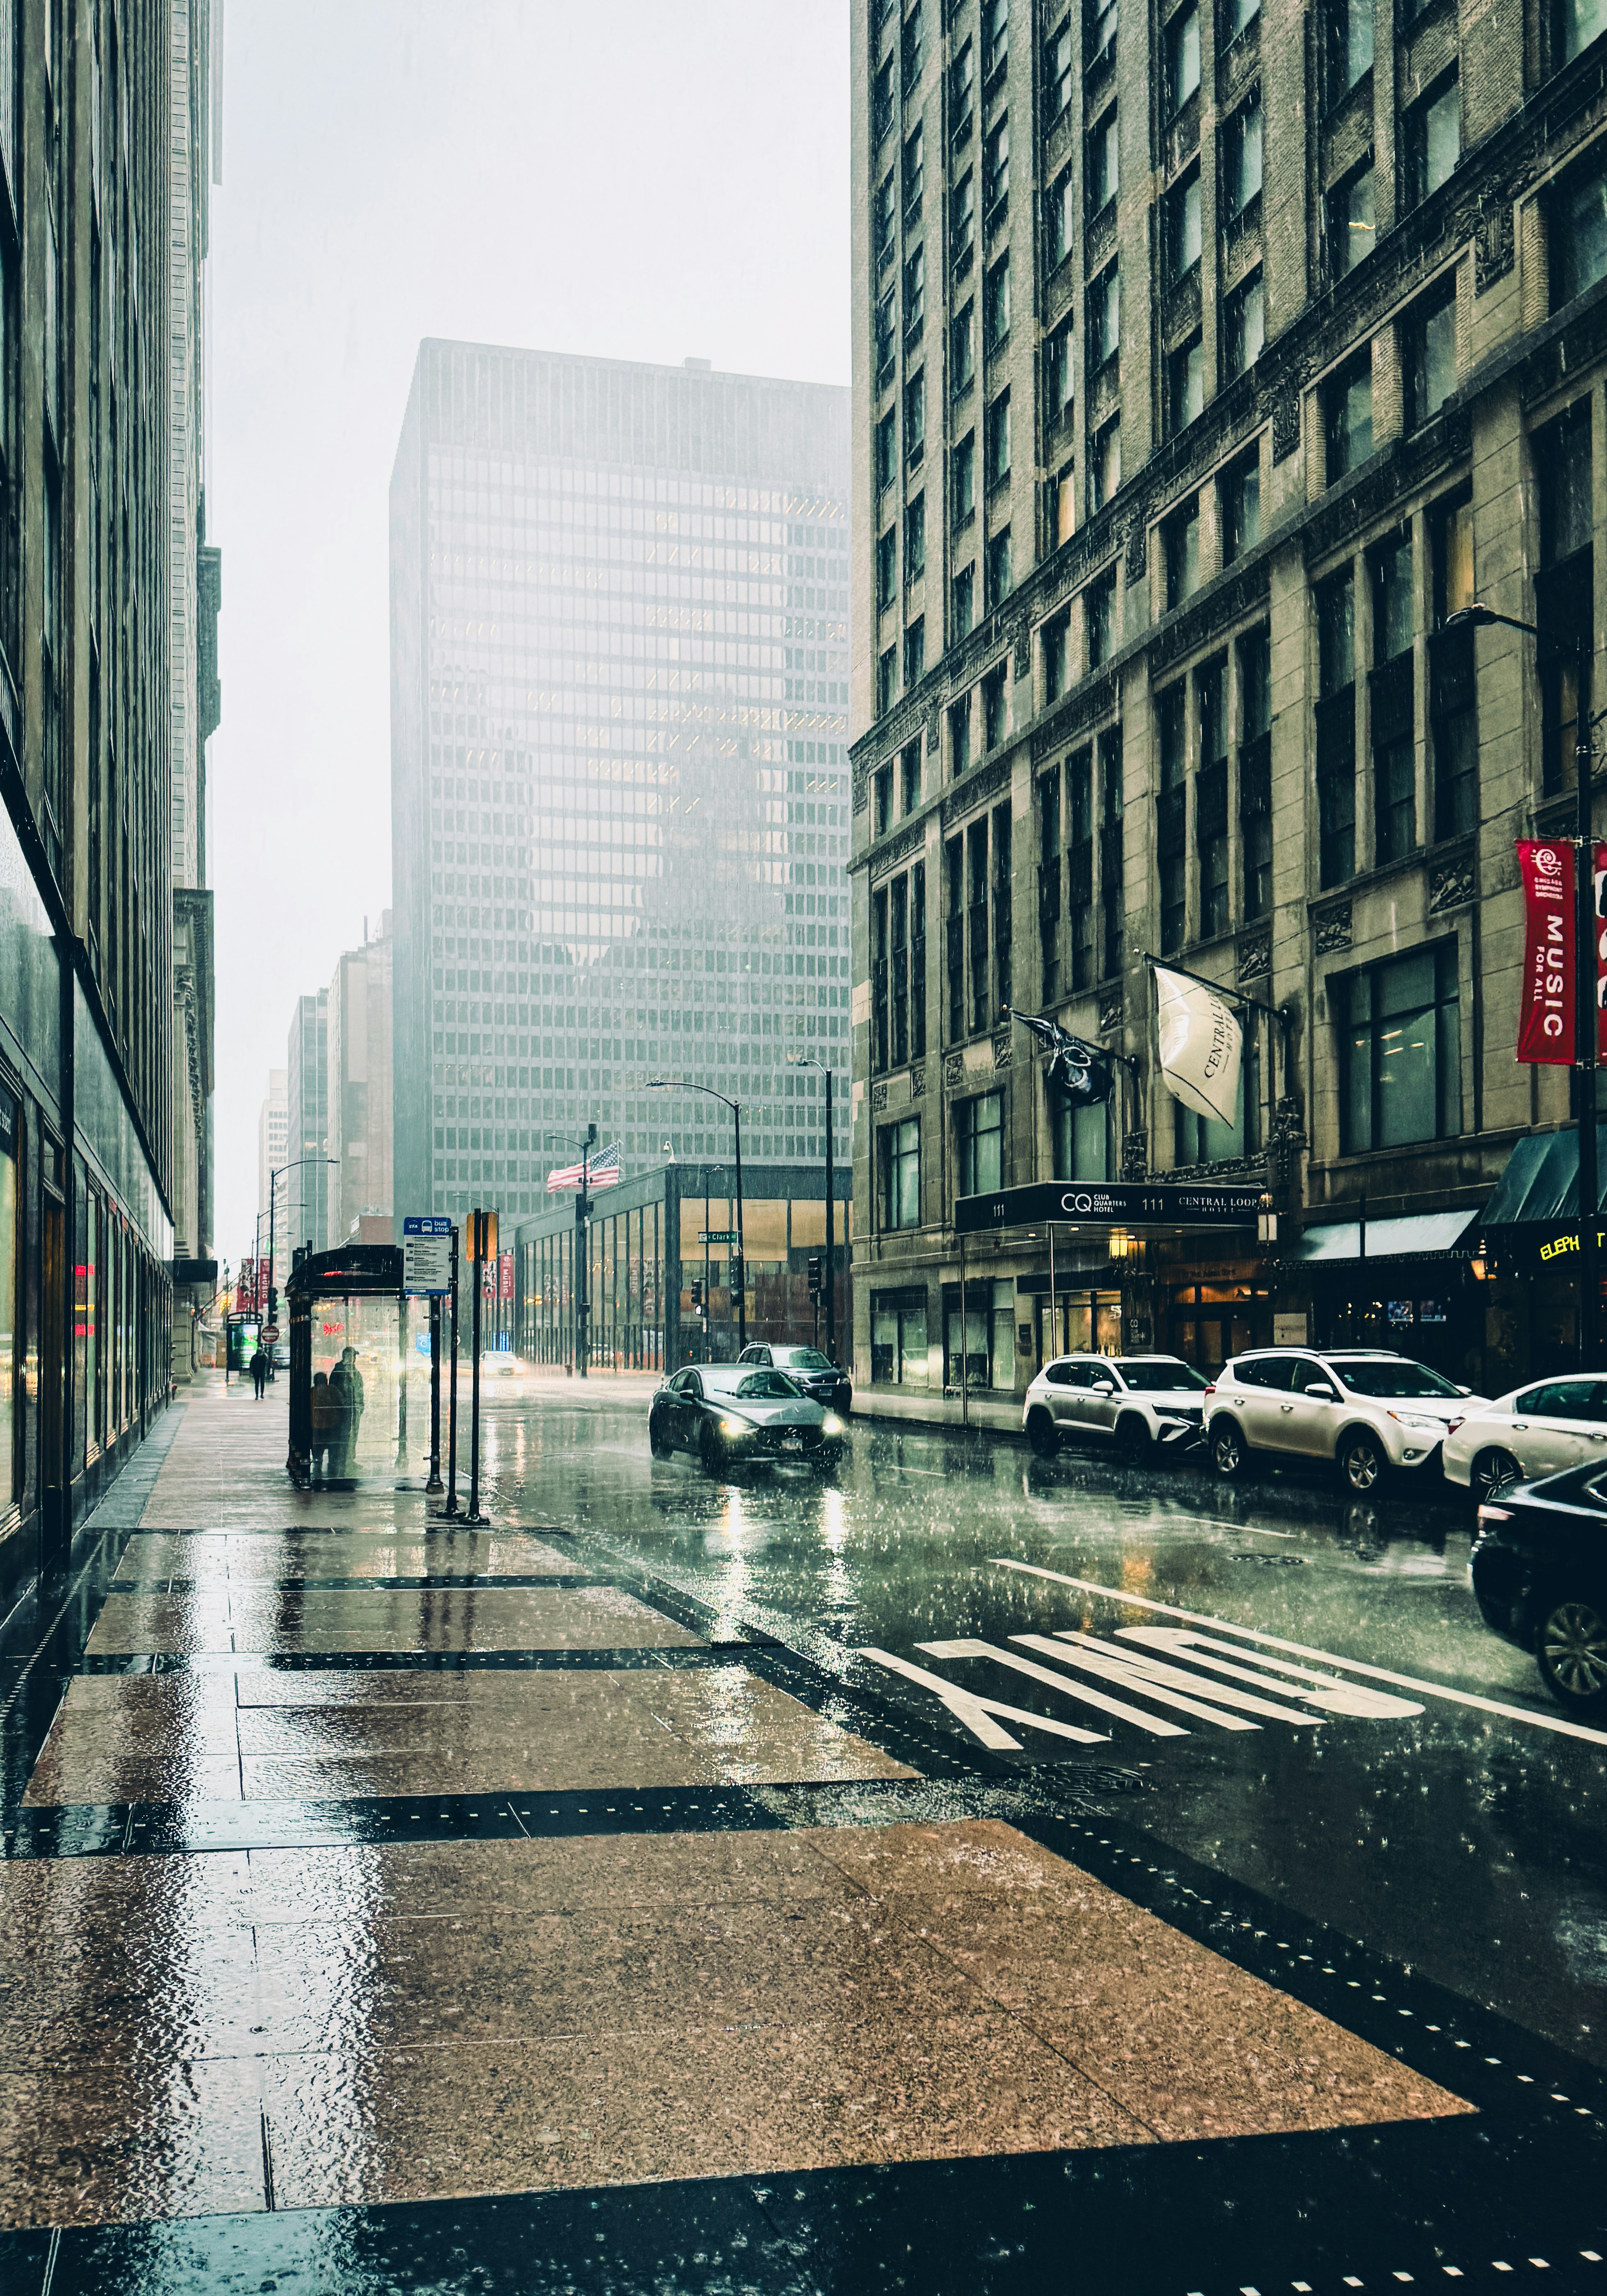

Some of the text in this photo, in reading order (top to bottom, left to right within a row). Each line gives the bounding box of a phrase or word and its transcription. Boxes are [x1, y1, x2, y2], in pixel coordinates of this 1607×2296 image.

[1533, 946, 1544, 1001] FOR ALL
[1544, 915, 1563, 1036] MUSIC
[1204, 1013, 1225, 1078] CENTRAL
[993, 1204, 1004, 1217] 111
[1061, 1193, 1092, 1212] CQ
[1142, 1198, 1163, 1211] 111
[1178, 1197, 1257, 1207] CENTRAL LOOP
[1540, 1232, 1605, 1261] ELEPHT
[856, 1627, 1426, 1750] ONLY
